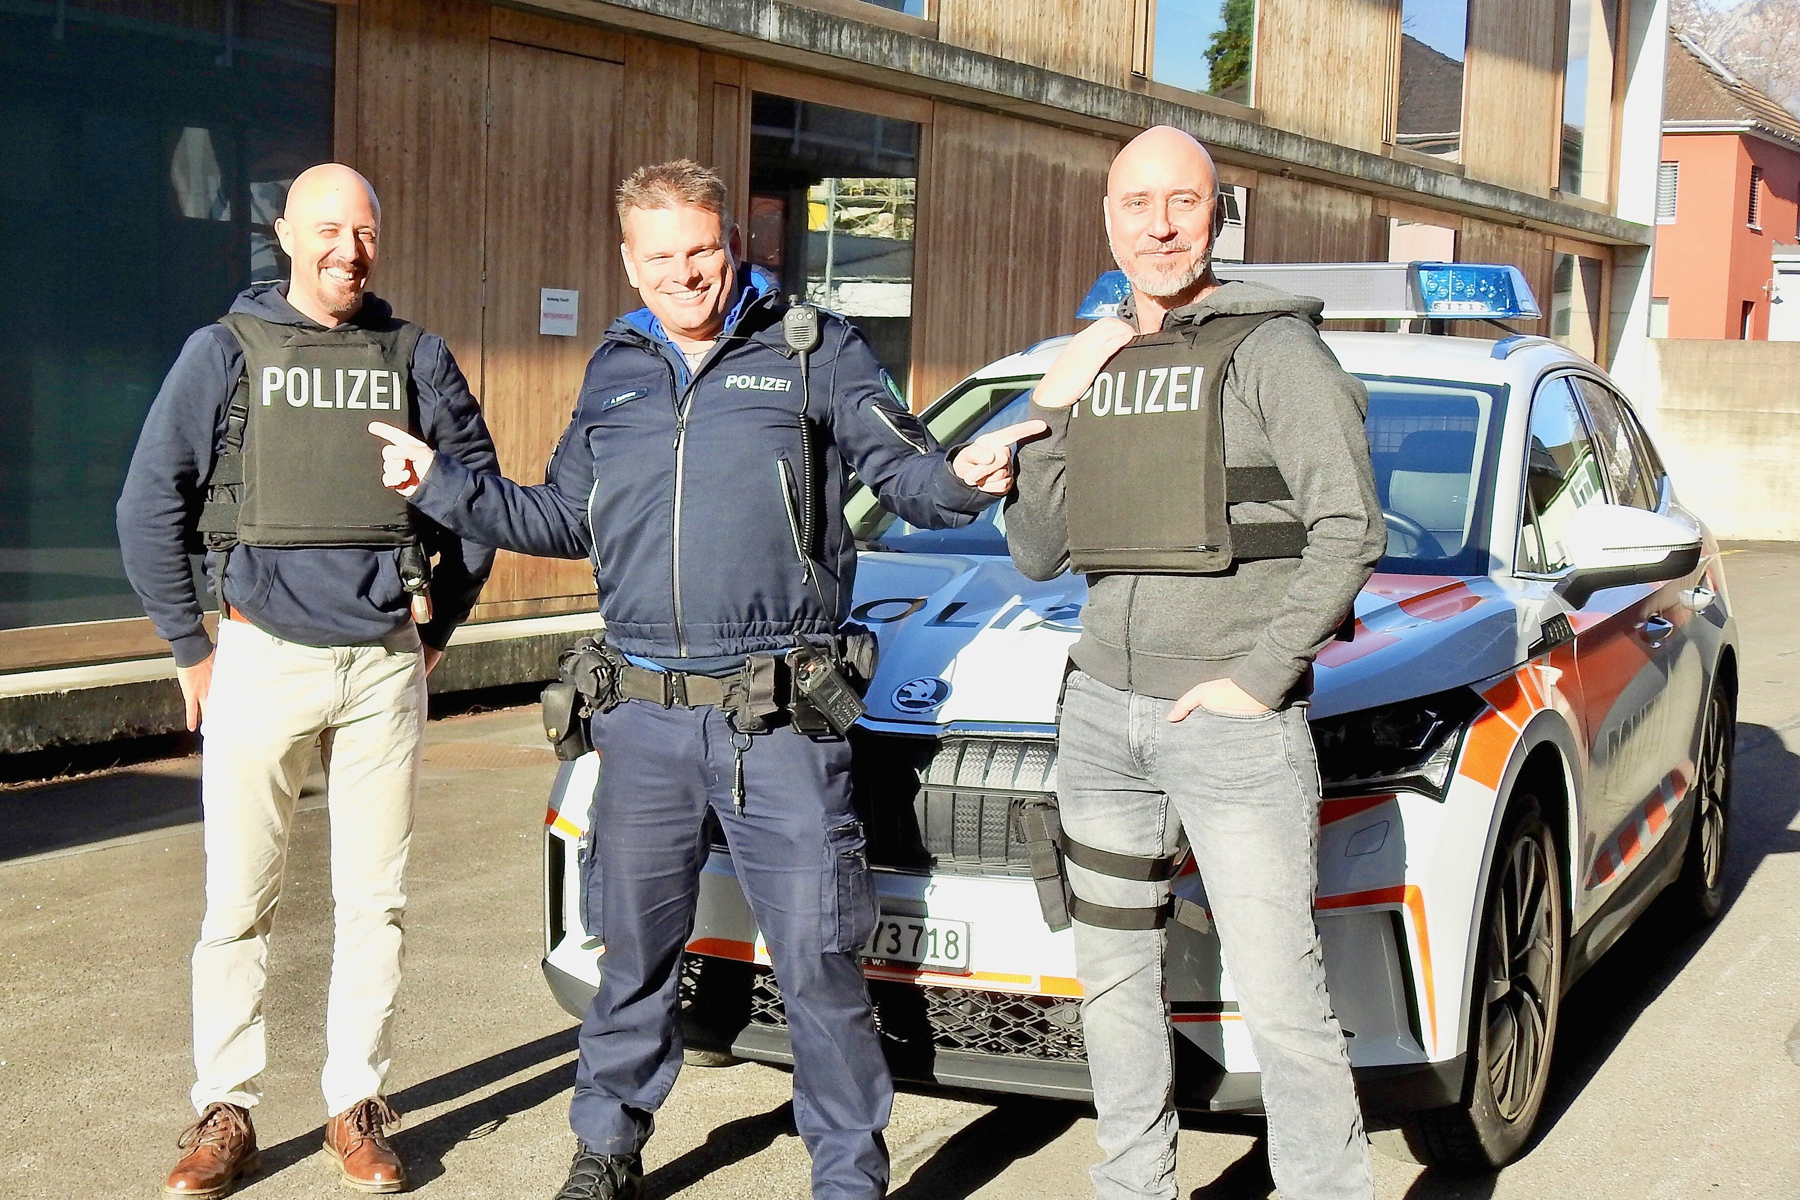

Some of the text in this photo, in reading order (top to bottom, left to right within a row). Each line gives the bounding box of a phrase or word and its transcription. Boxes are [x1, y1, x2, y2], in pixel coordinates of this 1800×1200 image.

[262, 366, 401, 411] POLIZEI
[725, 374, 792, 392] POLIZEI
[857, 921, 960, 961] 73718
